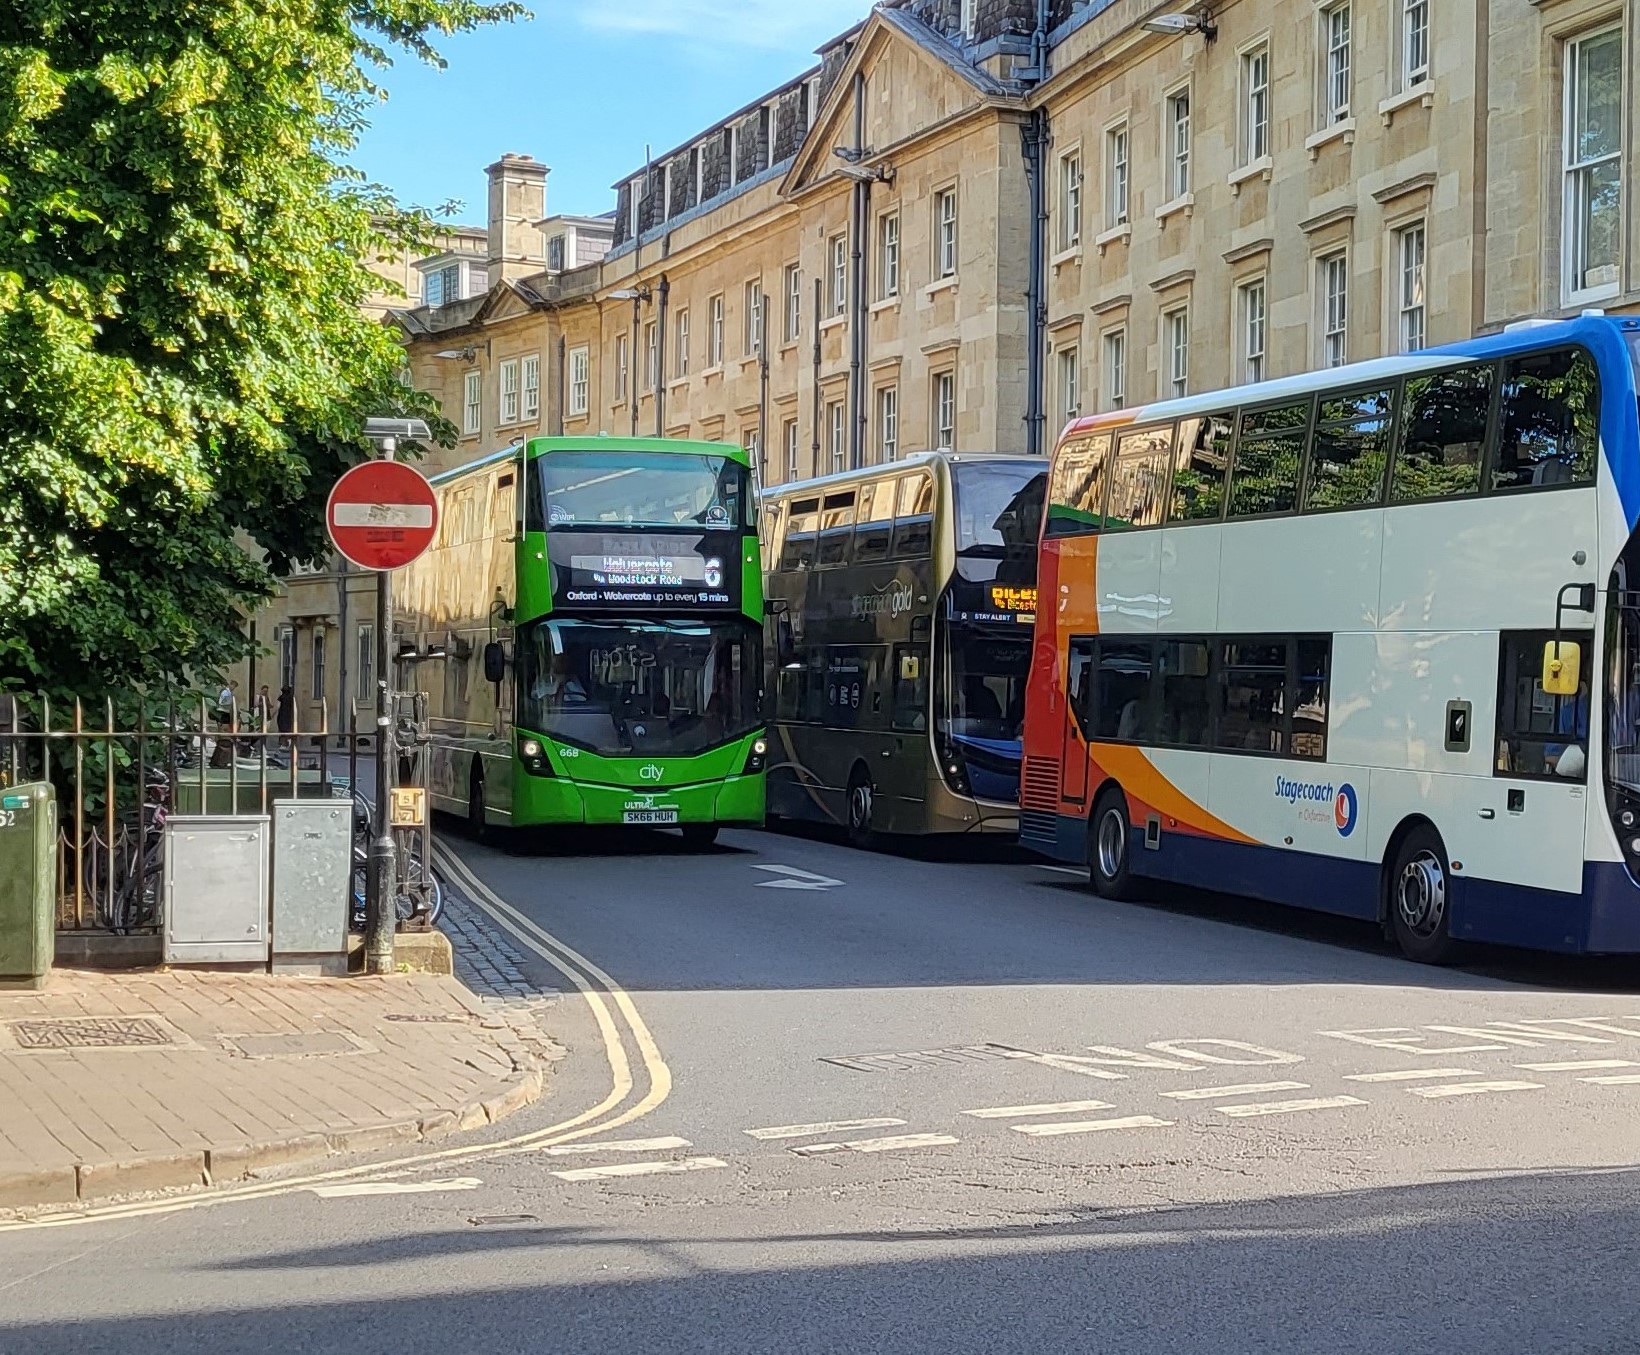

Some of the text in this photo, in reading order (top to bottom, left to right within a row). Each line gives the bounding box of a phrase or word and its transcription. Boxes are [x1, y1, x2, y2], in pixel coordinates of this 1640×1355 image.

[608, 574, 656, 585] Woodstock
[659, 574, 682, 585] Road
[567, 591, 728, 603] Oxford Wolvercote up to every 15 mins
[892, 583, 913, 618] gold
[990, 613, 1011, 621] ALERT
[640, 763, 664, 781] city
[1275, 775, 1333, 804] Stagecoach
[624, 801, 650, 809] ULTRA
[627, 812, 673, 822] SK66 HUH
[1004, 1015, 1640, 1079] NO ENT
